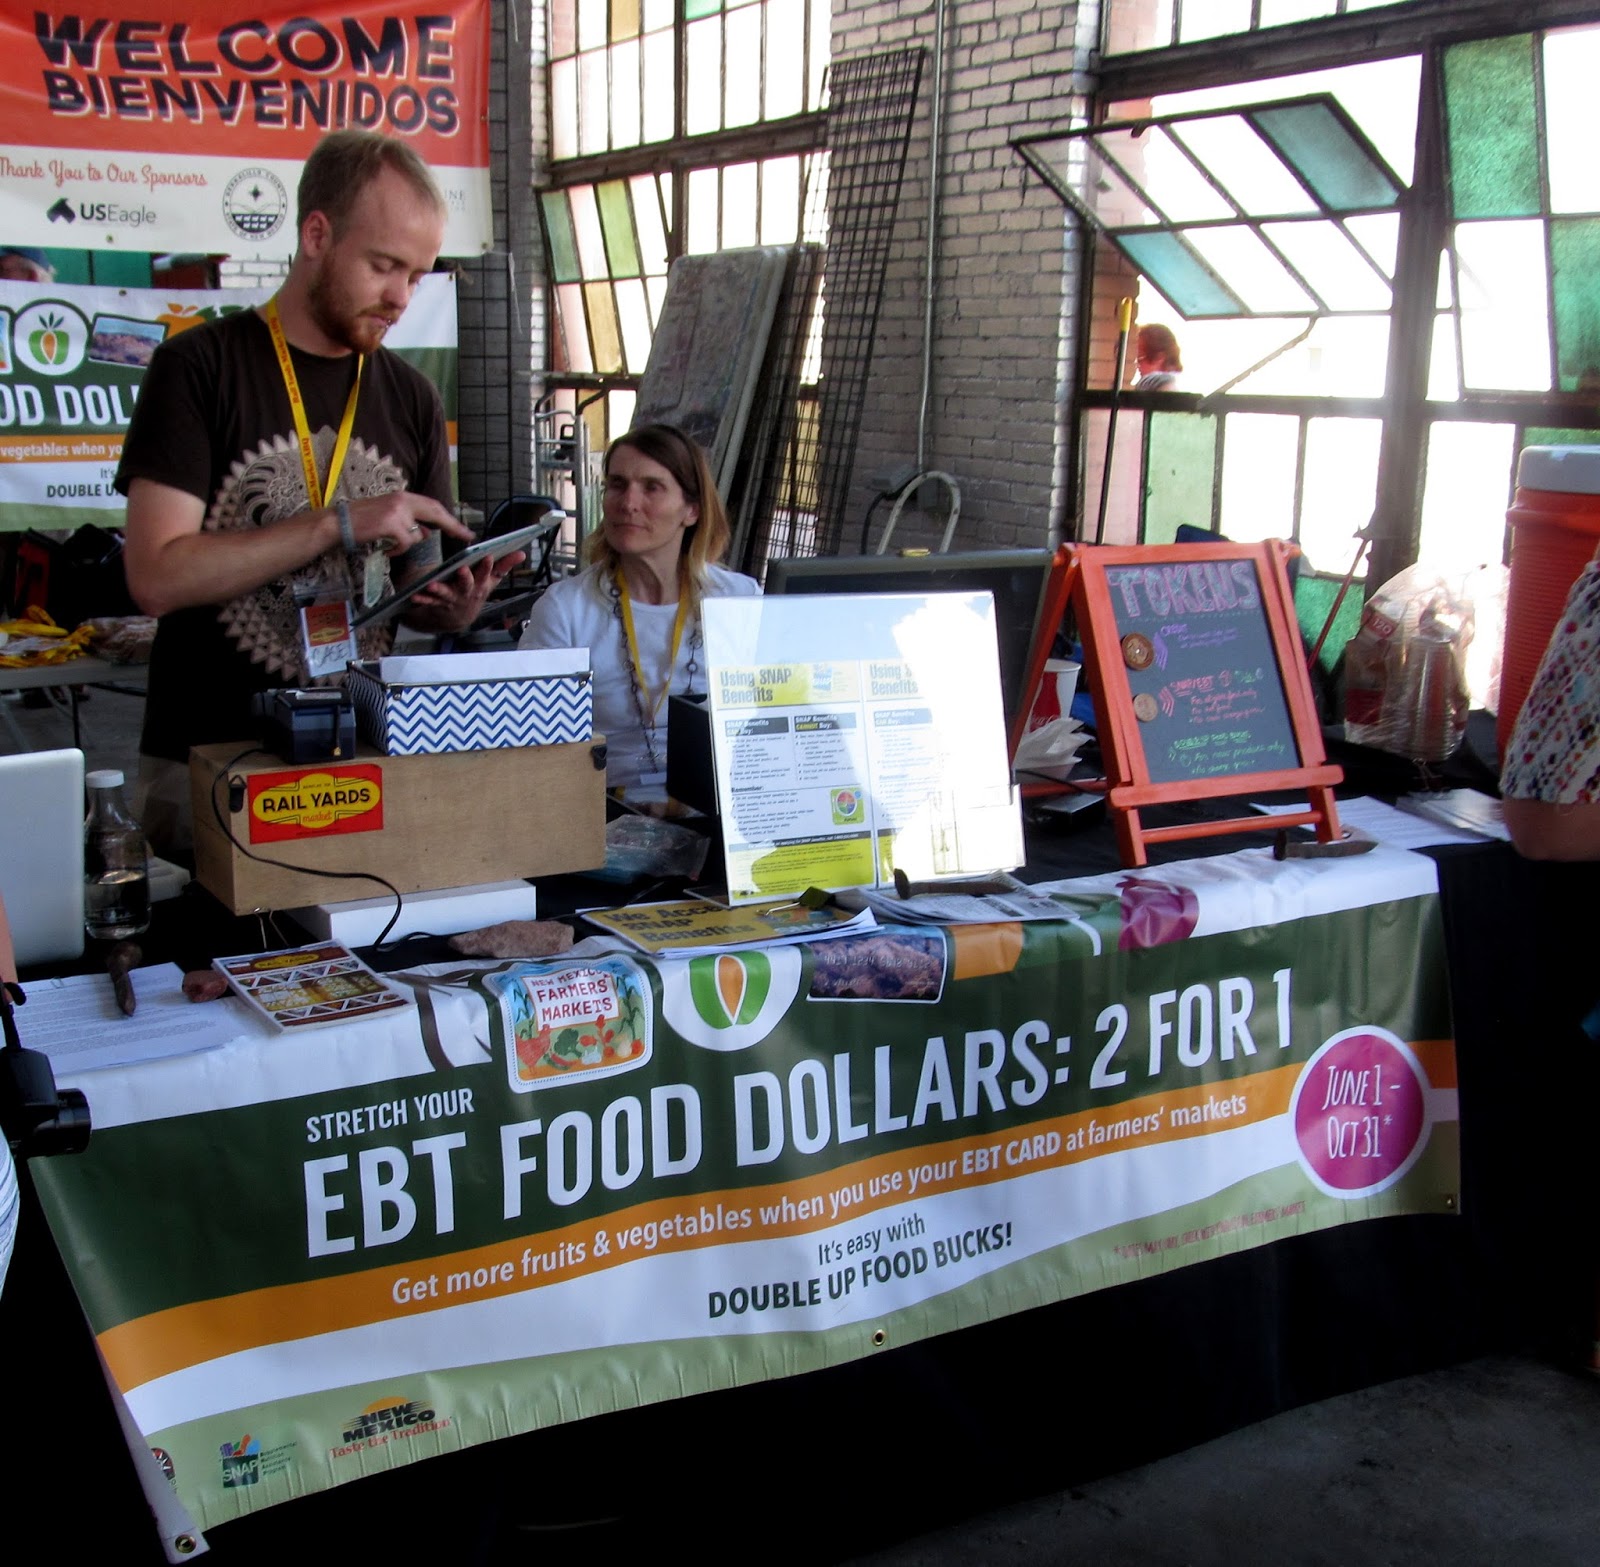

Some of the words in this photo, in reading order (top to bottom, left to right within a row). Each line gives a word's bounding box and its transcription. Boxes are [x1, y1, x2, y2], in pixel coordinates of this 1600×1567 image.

[34, 11, 456, 82] WELCOME
[43, 70, 460, 136] BIENVENIDOS
[0, 157, 43, 178] Thank
[49, 160, 84, 187] You
[88, 162, 103, 181] to
[107, 163, 137, 183] Our
[142, 164, 208, 192] Sponsors
[80, 203, 157, 227] USEagle
[1, 442, 68, 461] vegetables
[72, 442, 104, 456] when
[47, 485, 101, 498] DOUBLE
[1107, 562, 1259, 617] TOKENS
[720, 670, 755, 687] Using
[760, 668, 791, 684] SNAP
[870, 664, 901, 679] Using
[722, 687, 773, 704] Benefits
[871, 680, 918, 696] Benefits
[263, 794, 306, 813] RAIL
[311, 788, 370, 807] YARDS
[622, 918, 694, 932] SNAP
[638, 923, 757, 943] Benefits
[531, 978, 554, 988] NEW
[542, 997, 613, 1022] MARKETS
[303, 1131, 467, 1259] EBT
[499, 1083, 703, 1220] FOOD
[734, 1018, 1070, 1167] DOLLARS:
[1089, 1003, 1129, 1090] 2
[1148, 976, 1258, 1077] FOR
[1272, 968, 1293, 1049] 1
[306, 1098, 408, 1144] STRETCH
[414, 1087, 475, 1121] YOUR
[392, 1274, 438, 1304] Get
[446, 1261, 514, 1294] more
[521, 1241, 586, 1277] fruits
[593, 1230, 611, 1257] &
[616, 1203, 752, 1250] vegetables
[759, 1195, 824, 1226] when
[829, 1183, 864, 1220] you
[869, 1170, 903, 1198] use
[908, 1159, 957, 1194] your
[962, 1145, 1001, 1175] EBT
[1005, 1131, 1061, 1165] CARD
[1066, 1128, 1085, 1151] at
[1088, 1106, 1164, 1145] farmers'
[1170, 1094, 1247, 1127] markets
[818, 1241, 843, 1266] It's
[846, 1229, 882, 1254] easy
[887, 1213, 926, 1243] with
[708, 1278, 821, 1318] DOUBLE
[828, 1267, 856, 1300] UP
[862, 1247, 928, 1288] FOOD
[933, 1221, 1013, 1268] BUCKS!
[343, 1410, 436, 1443] MEXICO
[359, 1402, 413, 1426] NEW
[330, 1442, 365, 1458] Taste
[368, 1435, 389, 1448] the
[391, 1419, 451, 1440] Tradition
[223, 1460, 258, 1482] SNAP
